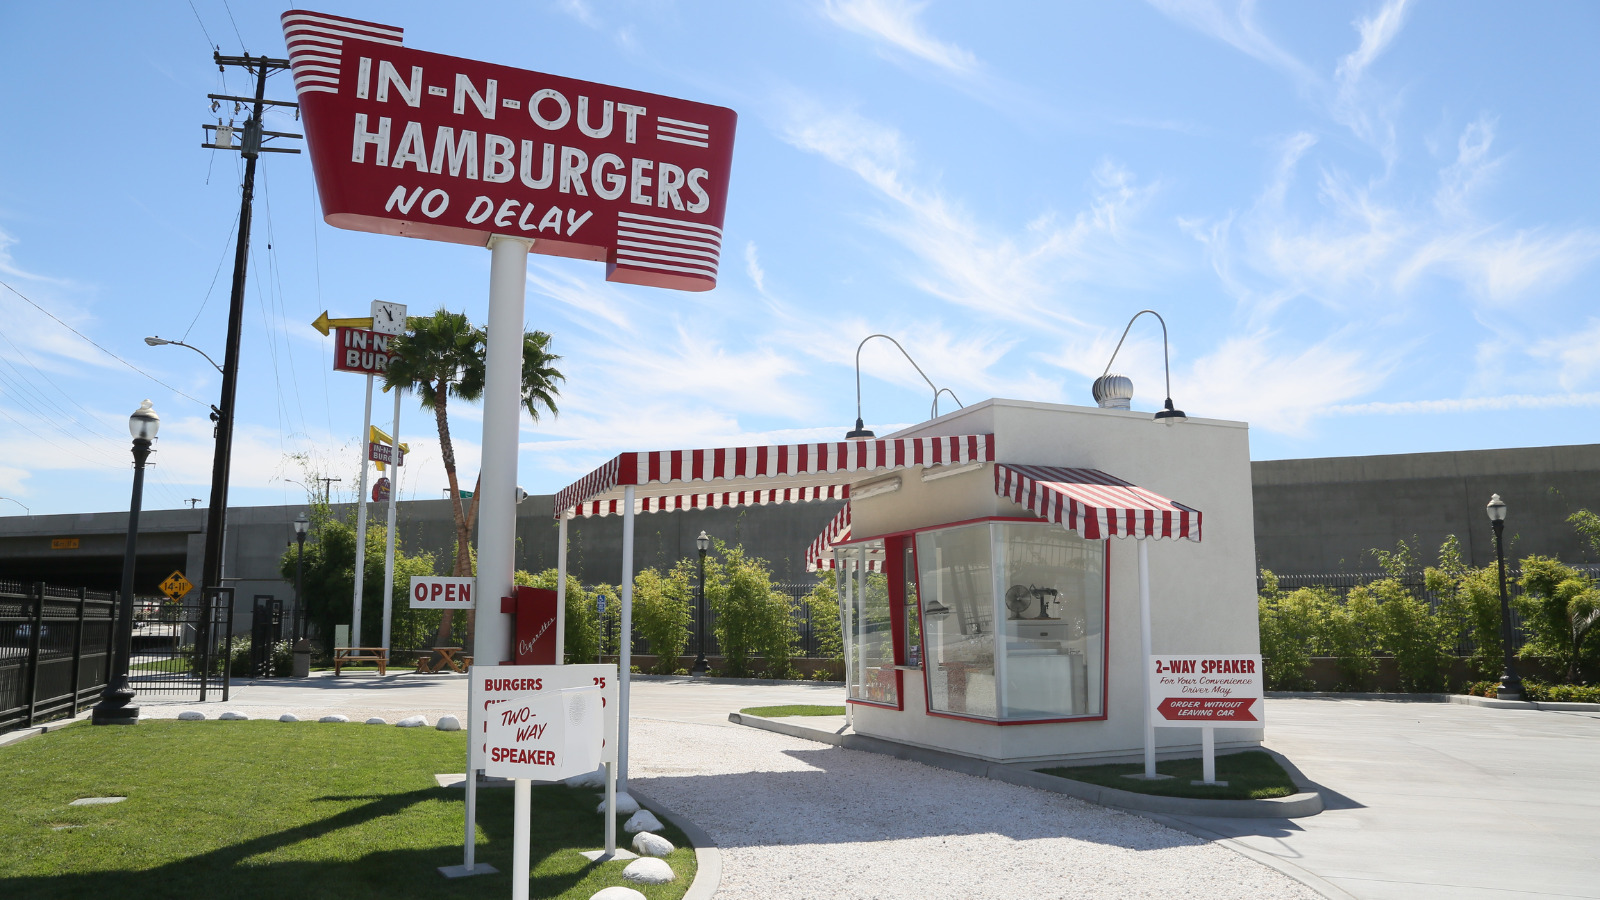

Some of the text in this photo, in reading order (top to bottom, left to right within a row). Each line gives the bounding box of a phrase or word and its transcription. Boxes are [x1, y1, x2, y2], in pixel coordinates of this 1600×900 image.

[356, 56, 646, 144] IN-N-OUT
[351, 112, 709, 214] HAMBURGERS
[384, 185, 593, 237] NO DELAY
[414, 582, 471, 602] OPEN
[519, 617, 556, 656] Cigarettes
[1155, 659, 1256, 674] 2-WAY SPEAKER
[484, 678, 543, 691] BURGERS
[1160, 676, 1253, 685] For Your Convenience
[1181, 685, 1233, 697] Driver May
[501, 706, 537, 727] TWO-
[1178, 709, 1235, 717] LEAVING CAR
[516, 722, 548, 743] WAY
[491, 747, 556, 766] SPEAKER
